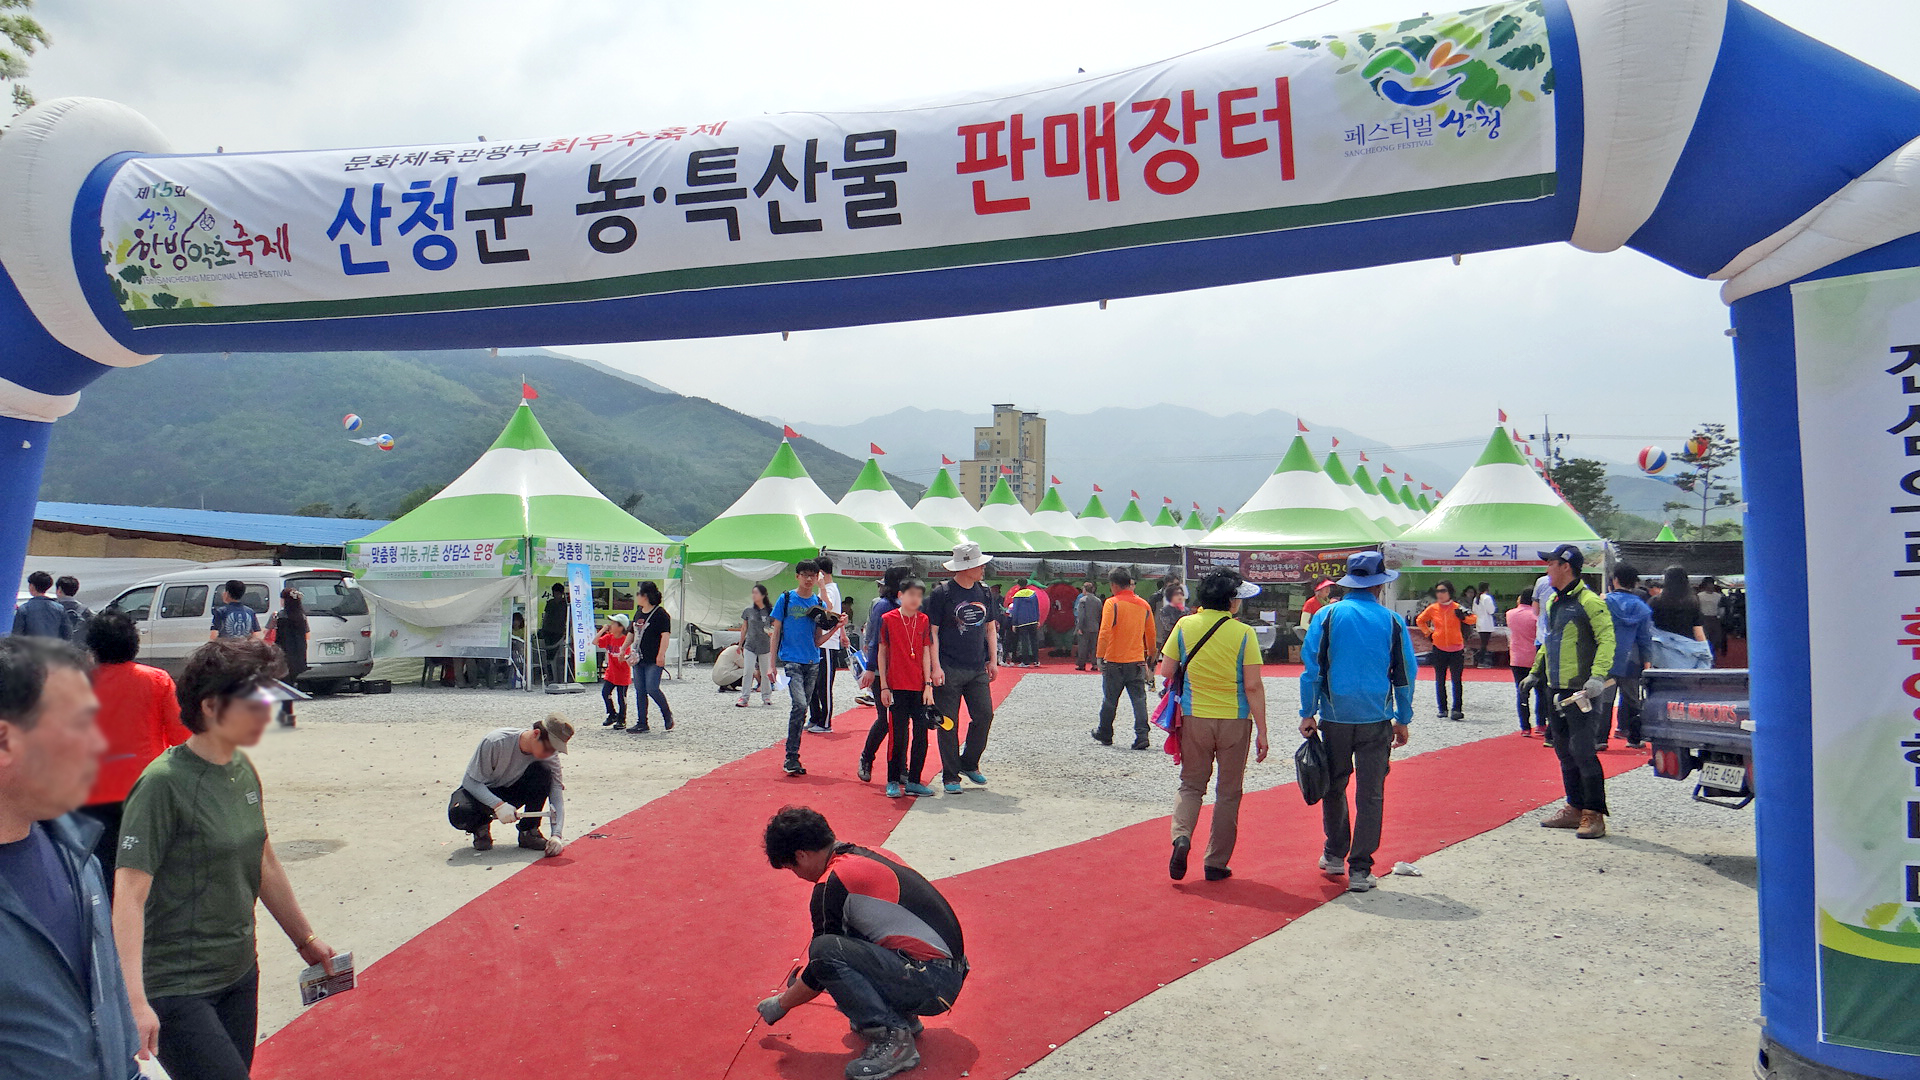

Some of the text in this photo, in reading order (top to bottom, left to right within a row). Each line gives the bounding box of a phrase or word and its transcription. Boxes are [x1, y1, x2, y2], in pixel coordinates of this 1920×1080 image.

[1344, 114, 1433, 146] 페스티벌
[344, 121, 728, 172] 문화체육관광부 최우수축제
[1344, 139, 1434, 158] SANCHEONG FESTIVAL
[327, 172, 533, 276] 산청군
[955, 77, 1297, 216] 판매장터
[134, 181, 190, 200] 제15회
[200, 273, 237, 283] MEDICINAL
[239, 271, 258, 280] HERB
[371, 546, 398, 564] 맞춤형
[443, 543, 471, 562] 상담소
[473, 542, 494, 561] 운영
[557, 542, 583, 560] 맞춤형
[623, 545, 646, 563] 상담소
[648, 547, 663, 564] 운영
[847, 556, 867, 569] 지리산
[1454, 544, 1518, 560] 소소재
[1687, 702, 1738, 724] MOTORS
